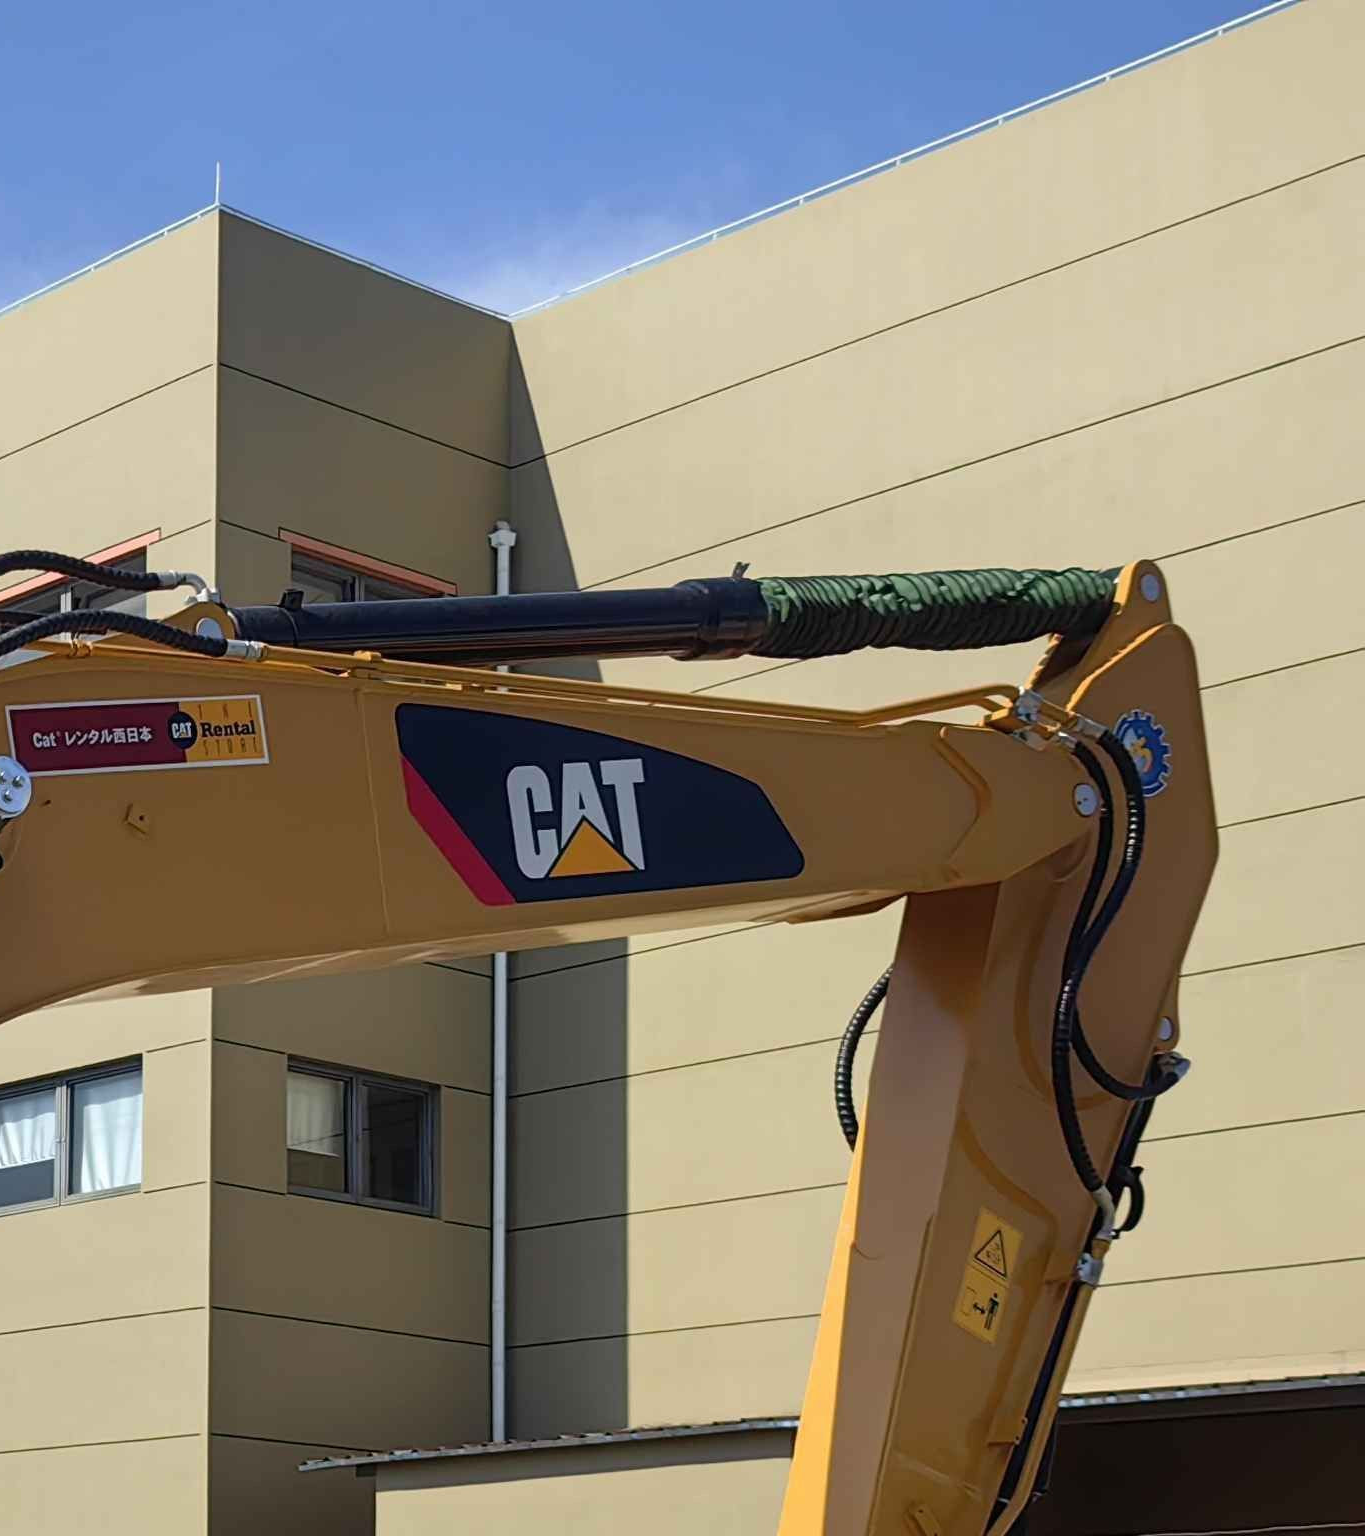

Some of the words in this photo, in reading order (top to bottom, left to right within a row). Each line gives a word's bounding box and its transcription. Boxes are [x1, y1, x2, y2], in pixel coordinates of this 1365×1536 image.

[65, 726, 153, 747] レンタル西日本
[171, 721, 193, 739] CAT
[199, 719, 256, 739] Rental
[506, 758, 646, 879] CAT
